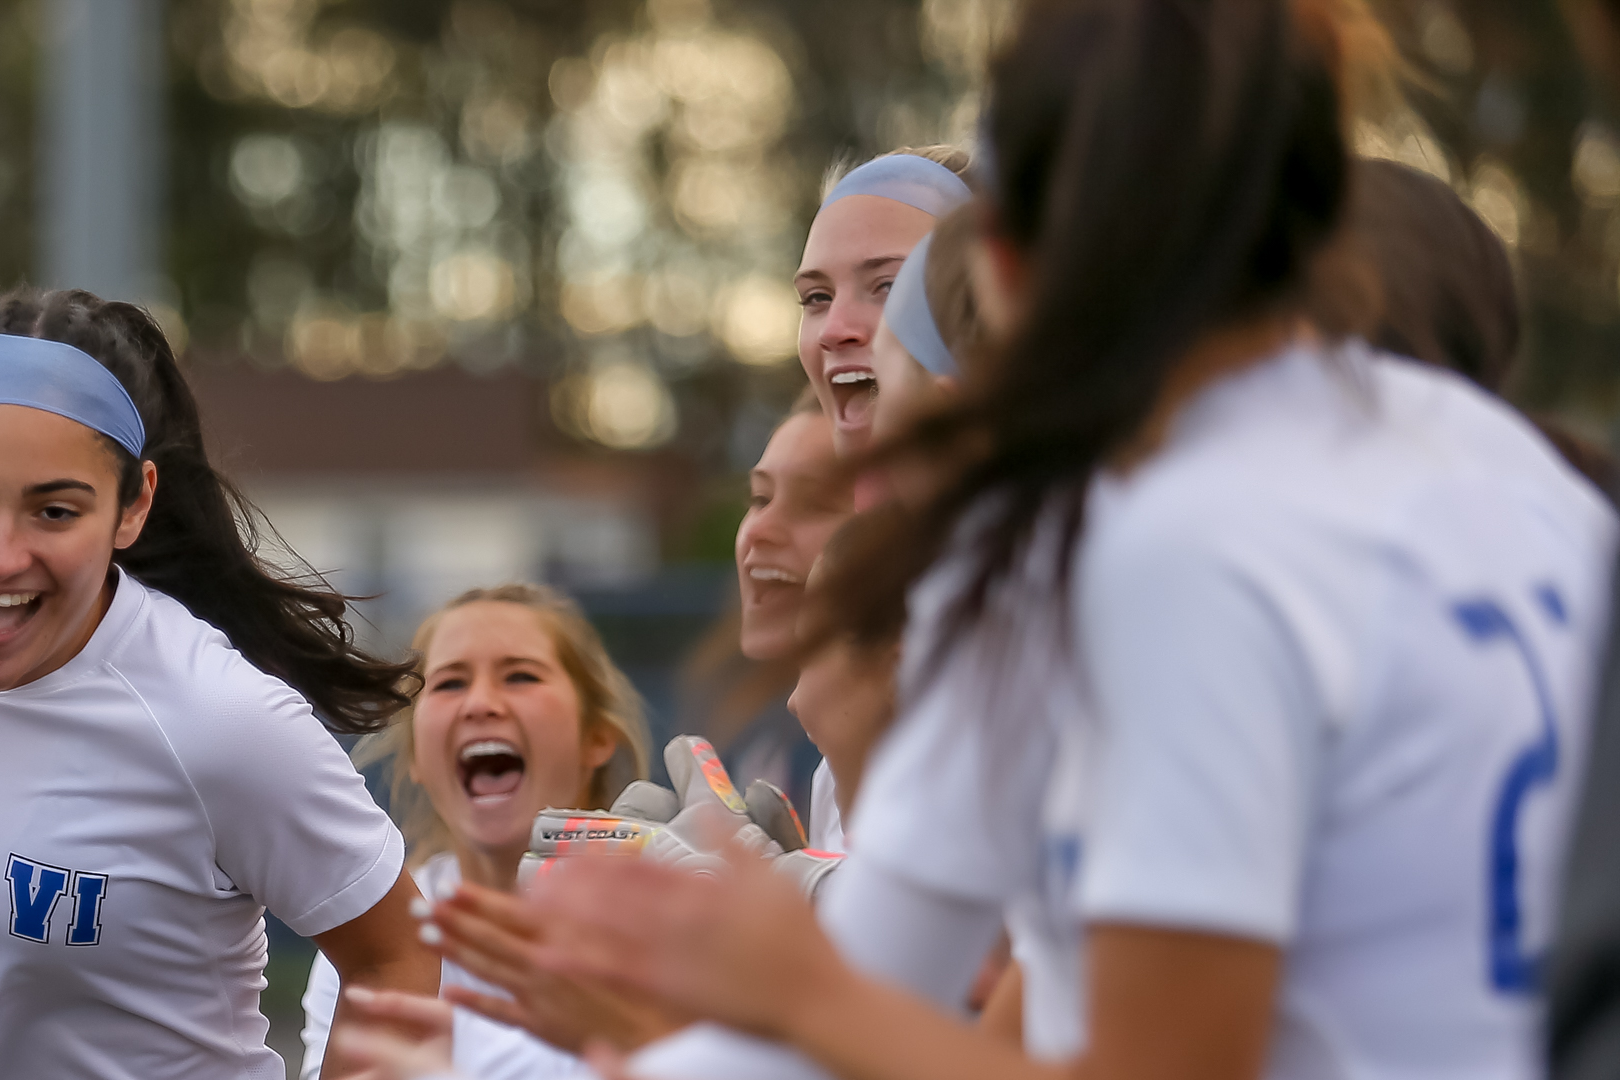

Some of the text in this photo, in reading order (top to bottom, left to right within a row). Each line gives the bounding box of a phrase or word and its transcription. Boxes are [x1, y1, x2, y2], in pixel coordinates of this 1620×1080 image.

[541, 829, 640, 842] WEST COAST
[4, 852, 109, 946] VI
